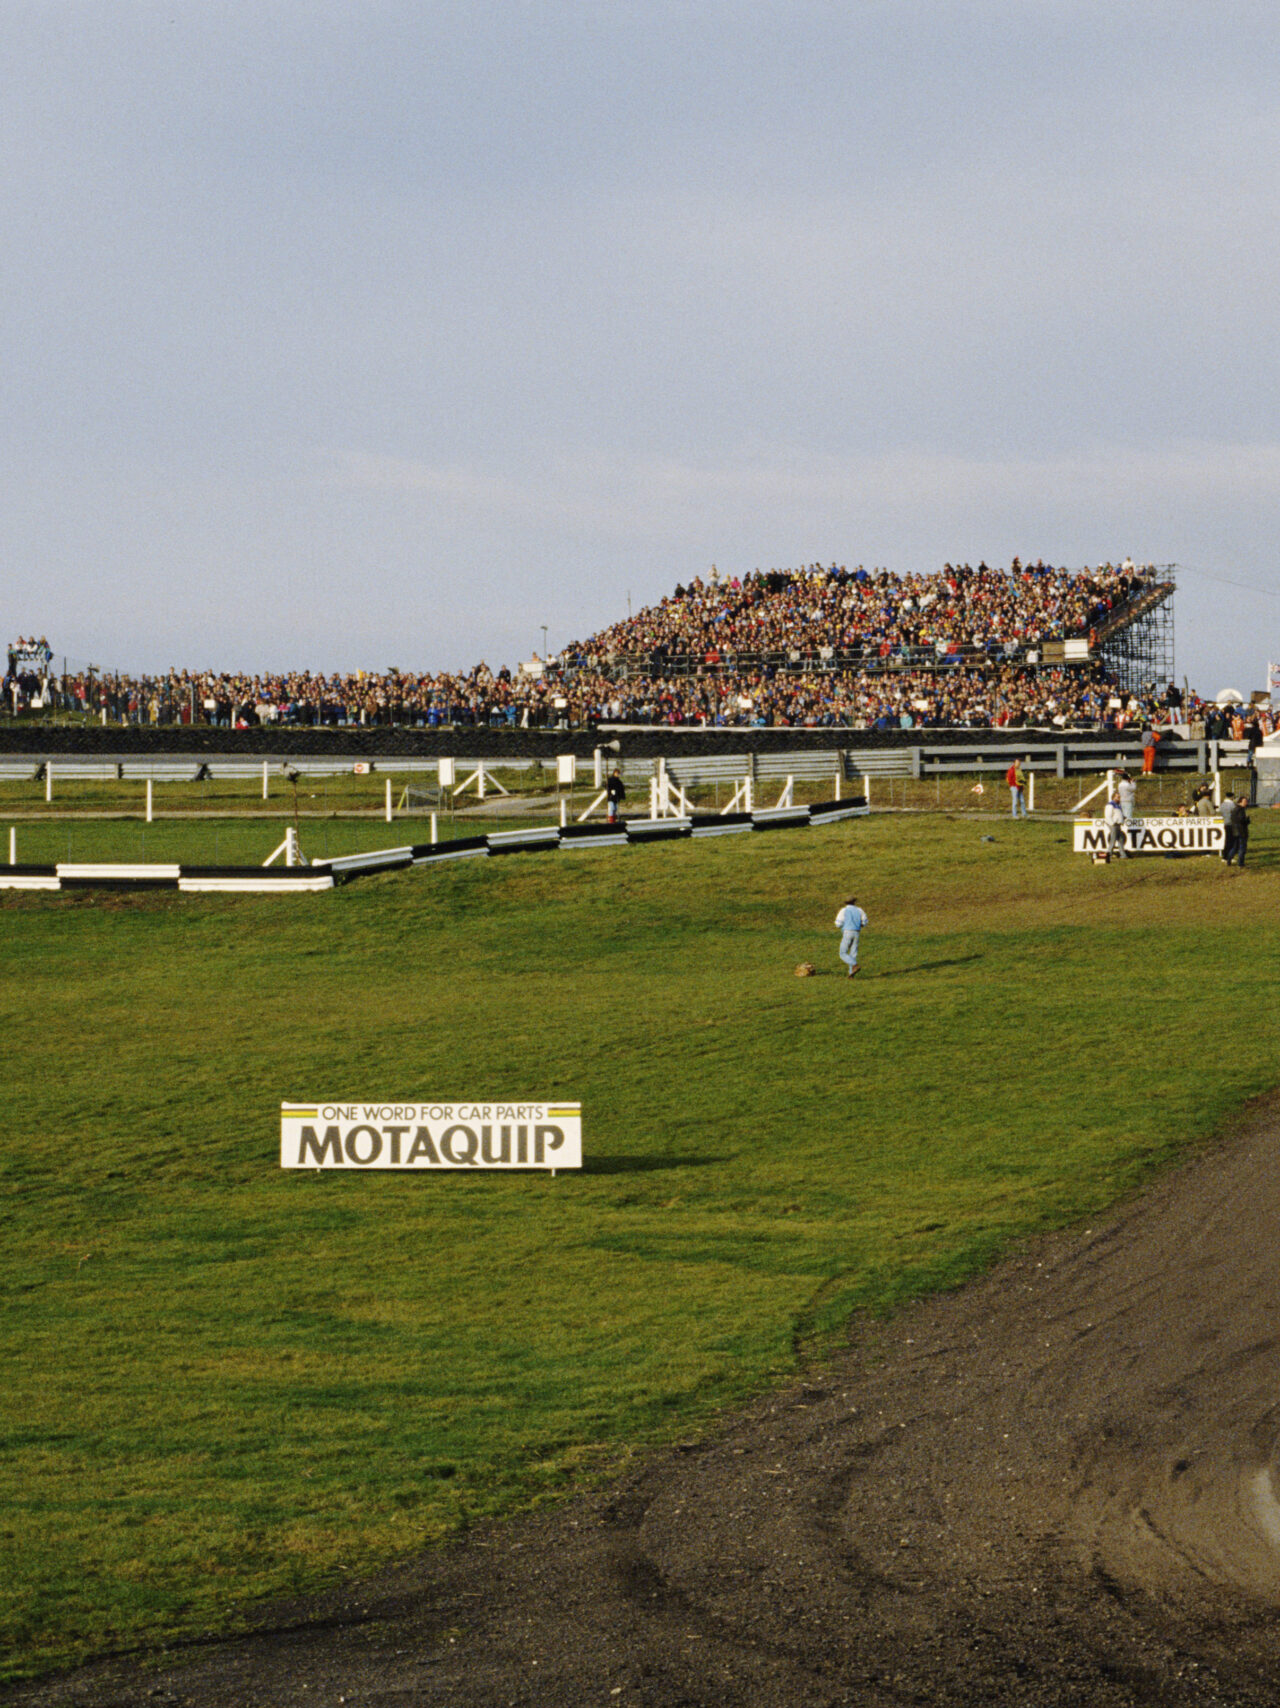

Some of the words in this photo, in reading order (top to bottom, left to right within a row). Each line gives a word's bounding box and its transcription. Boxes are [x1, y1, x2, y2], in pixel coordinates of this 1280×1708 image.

[1147, 819, 1163, 827] FOR
[1187, 818, 1212, 826] PARTS
[322, 1106, 360, 1121] ONE
[363, 1106, 416, 1120] WORD
[420, 1106, 455, 1120] FOR
[458, 1106, 492, 1120] CAR
[495, 1105, 544, 1120] PARTS
[297, 1124, 565, 1165] MOTAQUIP
